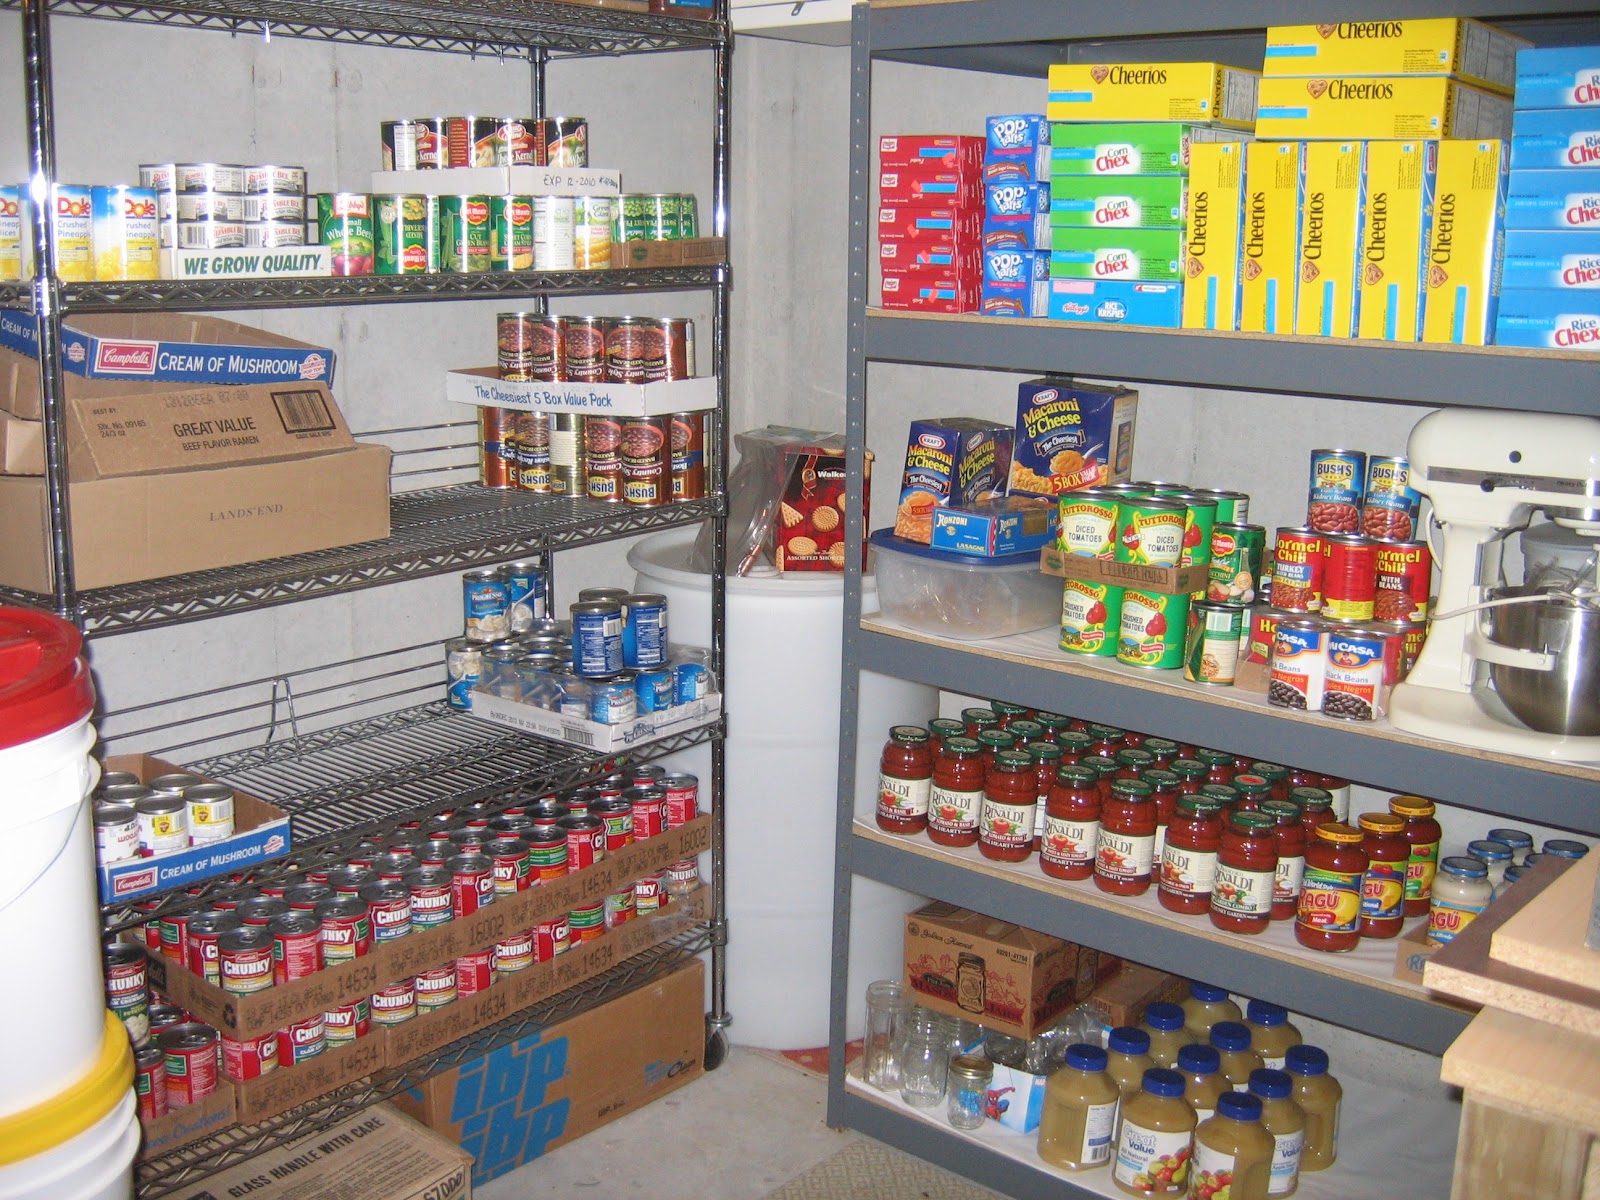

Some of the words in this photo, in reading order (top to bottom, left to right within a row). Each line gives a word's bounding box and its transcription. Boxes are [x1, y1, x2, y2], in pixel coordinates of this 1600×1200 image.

[1338, 21, 1403, 39] Cheerios
[1109, 65, 1167, 85] Cheerios
[1212, 69, 1223, 119] Cheerios
[1328, 79, 1394, 100] Cheerios
[1107, 146, 1128, 158] Corn
[1568, 146, 1600, 165] Che
[1095, 154, 1131, 172] Chex
[543, 174, 561, 186] EXP
[57, 197, 91, 216] Dole
[1107, 200, 1128, 211] Corn
[1095, 206, 1130, 224] Chex
[1567, 206, 1600, 225] Che
[1188, 191, 1209, 257] Cheerios
[1246, 191, 1266, 259] Cheerios
[1303, 192, 1325, 261] Cheerios
[1366, 192, 1388, 262] Cheerios
[1431, 193, 1456, 265] Cheerios
[184, 257, 208, 275] WE
[212, 255, 259, 274] GROW
[263, 254, 321, 273] QUALITY
[1106, 252, 1127, 263] Corn
[1095, 257, 1130, 276] Chex
[1096, 308, 1125, 319] KRISPIES
[1104, 301, 1118, 309] RICE
[1, 317, 21, 334] CREAM
[22, 326, 31, 338] OF
[1571, 319, 1597, 332] Rice
[1555, 328, 1600, 347] Chex
[159, 352, 203, 371] CREAM
[208, 357, 224, 372] OF
[228, 354, 297, 374] MUSHROOM
[475, 385, 490, 399] The
[491, 386, 531, 404] Cheesiest
[534, 392, 541, 404] 5
[543, 391, 562, 405] Box
[564, 391, 587, 406] Value
[589, 392, 613, 407] Pack
[1037, 393, 1054, 401] KRAFT
[1022, 398, 1080, 429] Macaroni
[173, 421, 213, 437] GREAT
[216, 416, 256, 433] VALUE
[1028, 426, 1037, 439] &
[1037, 412, 1082, 434] Cheese
[182, 441, 202, 451] BEEF
[204, 438, 231, 449] FLAVOR
[234, 435, 259, 447] RAMEN
[923, 438, 941, 446] KRAFT
[1041, 440, 1052, 453] The
[1051, 435, 1078, 445] Cheesiest
[908, 445, 954, 467] Macaroni
[958, 437, 995, 478] Macaroni
[915, 455, 951, 475] Cheese
[966, 453, 995, 480] Cheese
[1316, 462, 1354, 477] BUSH'S
[909, 474, 919, 485] The
[919, 475, 943, 492] Cheesiest
[1053, 477, 1062, 492] 5
[1061, 474, 1081, 489] BOX
[1372, 466, 1408, 483] BUSH'S
[623, 487, 655, 499] BUSH'S
[1313, 493, 1332, 502] Kidney
[1333, 495, 1353, 503] Beans
[1061, 504, 1114, 519] TUTTOROSSO
[1386, 500, 1405, 509] Beans
[936, 514, 968, 528] RONZONI
[1075, 524, 1096, 533] DICED
[1138, 514, 1187, 527] TUTTOROSS
[1068, 532, 1103, 543] TOMATOES
[1156, 535, 1175, 544] DICED
[956, 542, 985, 552] LASAGNE
[1147, 543, 1180, 553] TOMATOES
[1277, 550, 1308, 563] Chili
[1378, 549, 1421, 563] ormel
[1276, 563, 1305, 574] TURKEY
[1378, 561, 1407, 575] Chili
[1378, 581, 1403, 591] BEANS
[1380, 575, 1401, 584] WITH
[1123, 612, 1144, 625] CRUSHED
[1279, 662, 1301, 673] Beans
[1278, 675, 1305, 684] Negros
[1344, 673, 1370, 684] Beans
[1343, 684, 1372, 694] Negros
[932, 791, 971, 810] RINALDI
[984, 805, 1025, 824] RINALDI
[938, 825, 963, 835] HEARTY
[1044, 819, 1085, 841] RINALDI
[990, 839, 1014, 849] HEARTY
[160, 864, 193, 881] CREAM
[195, 858, 208, 871] OF
[210, 844, 261, 868] MUSHROOM
[1049, 856, 1074, 866] HEARTY
[1214, 867, 1255, 892] RINALDI
[410, 893, 451, 909] CHUNKY
[496, 938, 532, 957] CHUNKY
[223, 957, 270, 975] CHUNKY
[415, 974, 455, 991] CHUNKY
[372, 989, 414, 1008] CHUNKY
[1123, 1123, 1158, 1148] Great
[1128, 1139, 1156, 1155] Value
[228, 1173, 272, 1199] GLASS
[269, 1150, 320, 1180] HANDLE
[318, 1133, 354, 1155] WITH
[352, 1116, 385, 1138] CARE
[1128, 1150, 1149, 1162] Natural
